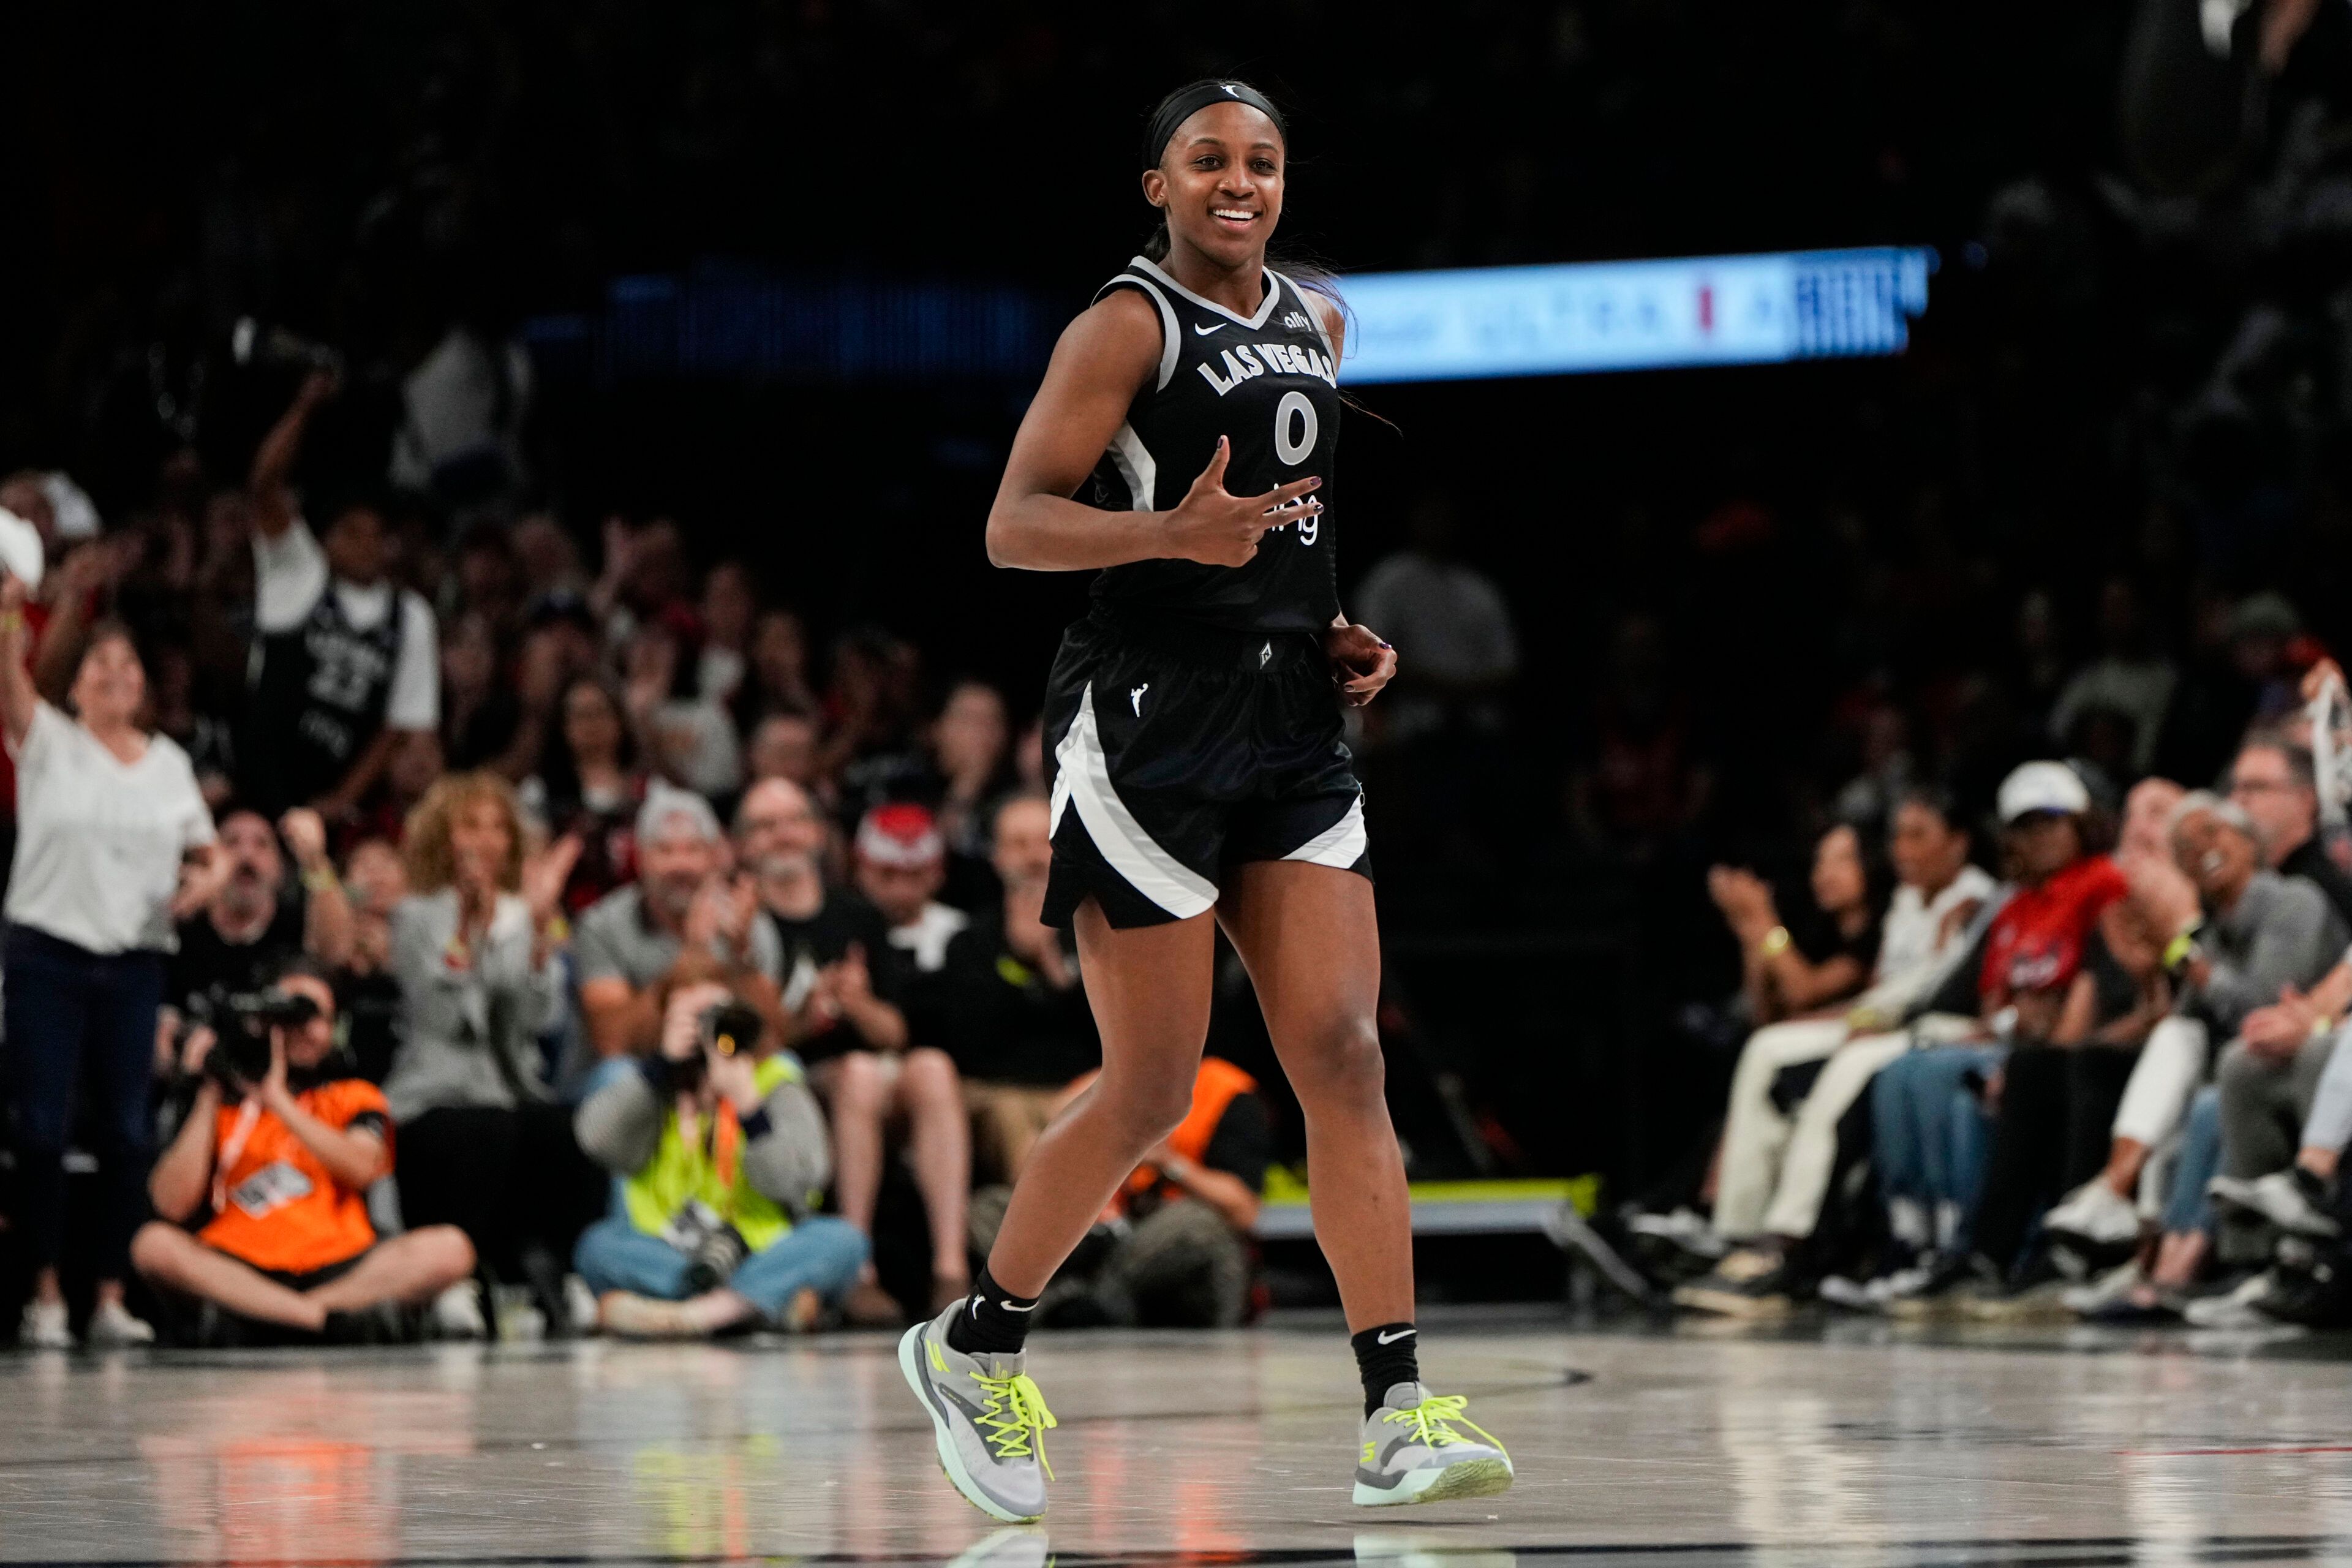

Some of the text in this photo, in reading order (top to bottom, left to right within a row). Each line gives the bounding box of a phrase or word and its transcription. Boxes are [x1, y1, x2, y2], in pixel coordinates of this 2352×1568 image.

[1284, 312, 1312, 331] ally
[1196, 343, 1337, 397] LAS VEGAS
[1275, 391, 1318, 466] 0
